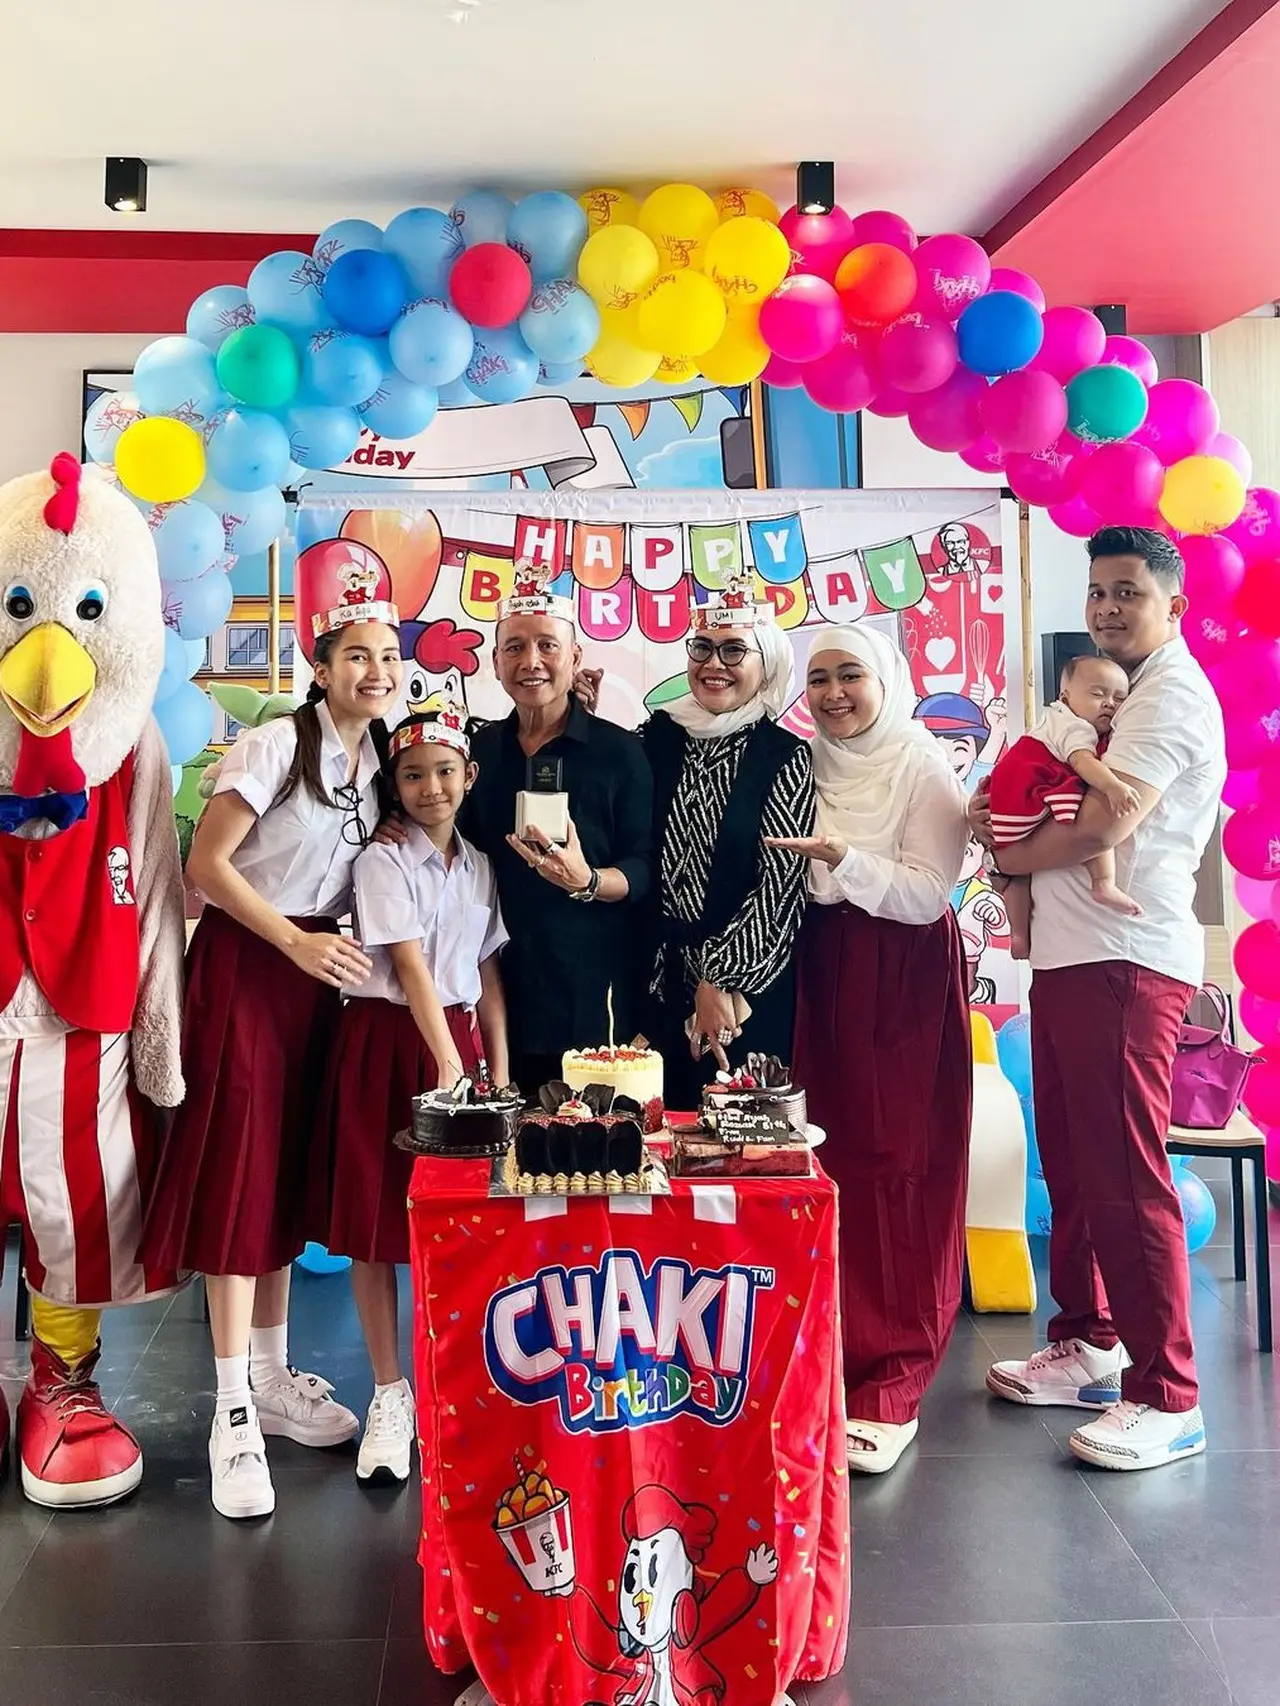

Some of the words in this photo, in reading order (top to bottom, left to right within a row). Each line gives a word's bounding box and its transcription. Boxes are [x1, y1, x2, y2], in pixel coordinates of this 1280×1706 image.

[522, 524, 790, 573] HAPPY
[970, 547, 989, 556] KFC
[469, 559, 907, 628] BRTDAY
[714, 611, 734, 620] UMI
[493, 1256, 749, 1384] CHAKI
[545, 1561, 563, 1578] KFC
